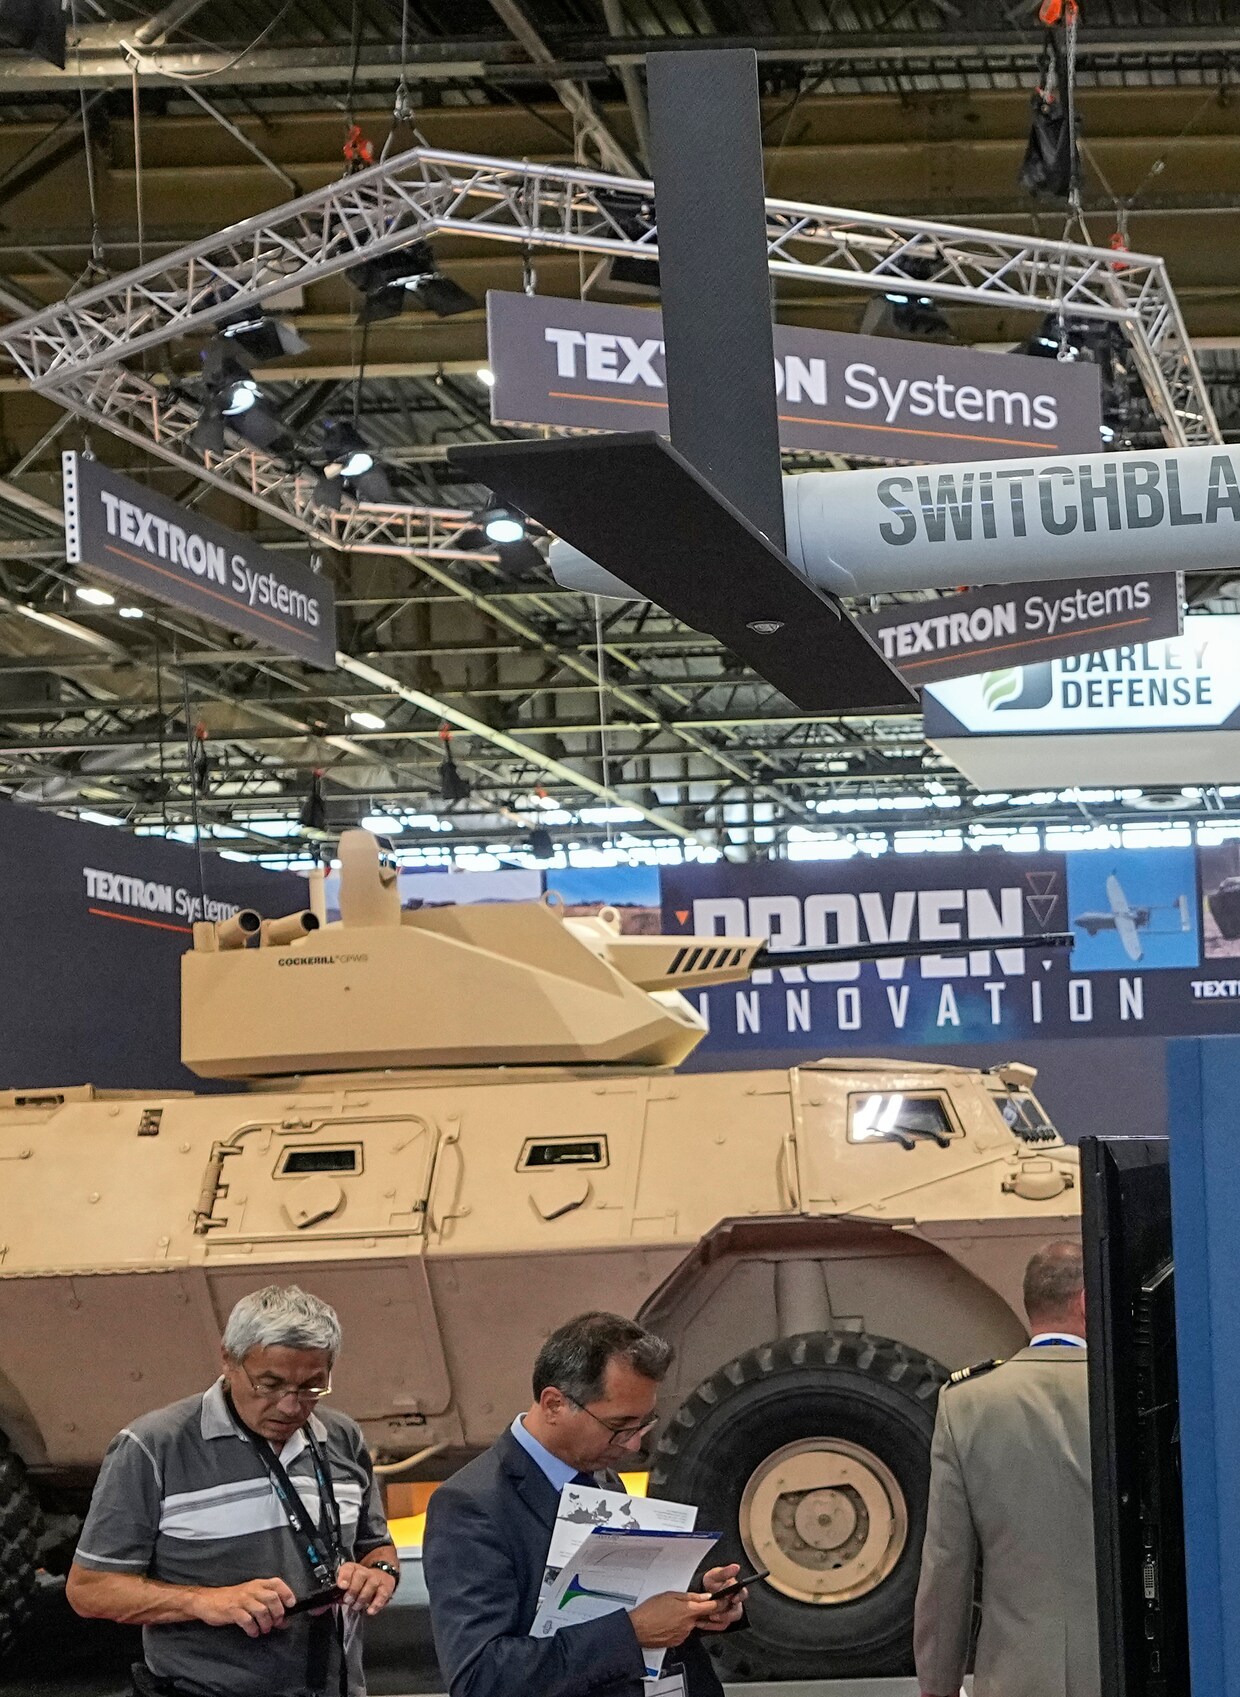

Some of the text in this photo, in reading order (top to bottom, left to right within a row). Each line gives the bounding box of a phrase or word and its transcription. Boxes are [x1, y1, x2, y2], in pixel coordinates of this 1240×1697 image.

[545, 328, 1058, 430] TEXN Systems
[101, 490, 320, 626] TEXTRON Systems
[878, 581, 1151, 659] TEXTRON Systems
[1061, 676, 1213, 709] DEFENSE
[83, 867, 172, 914] TEXTRON
[278, 956, 334, 967] COCKERILL
[699, 976, 1144, 1034] INNOVATION
